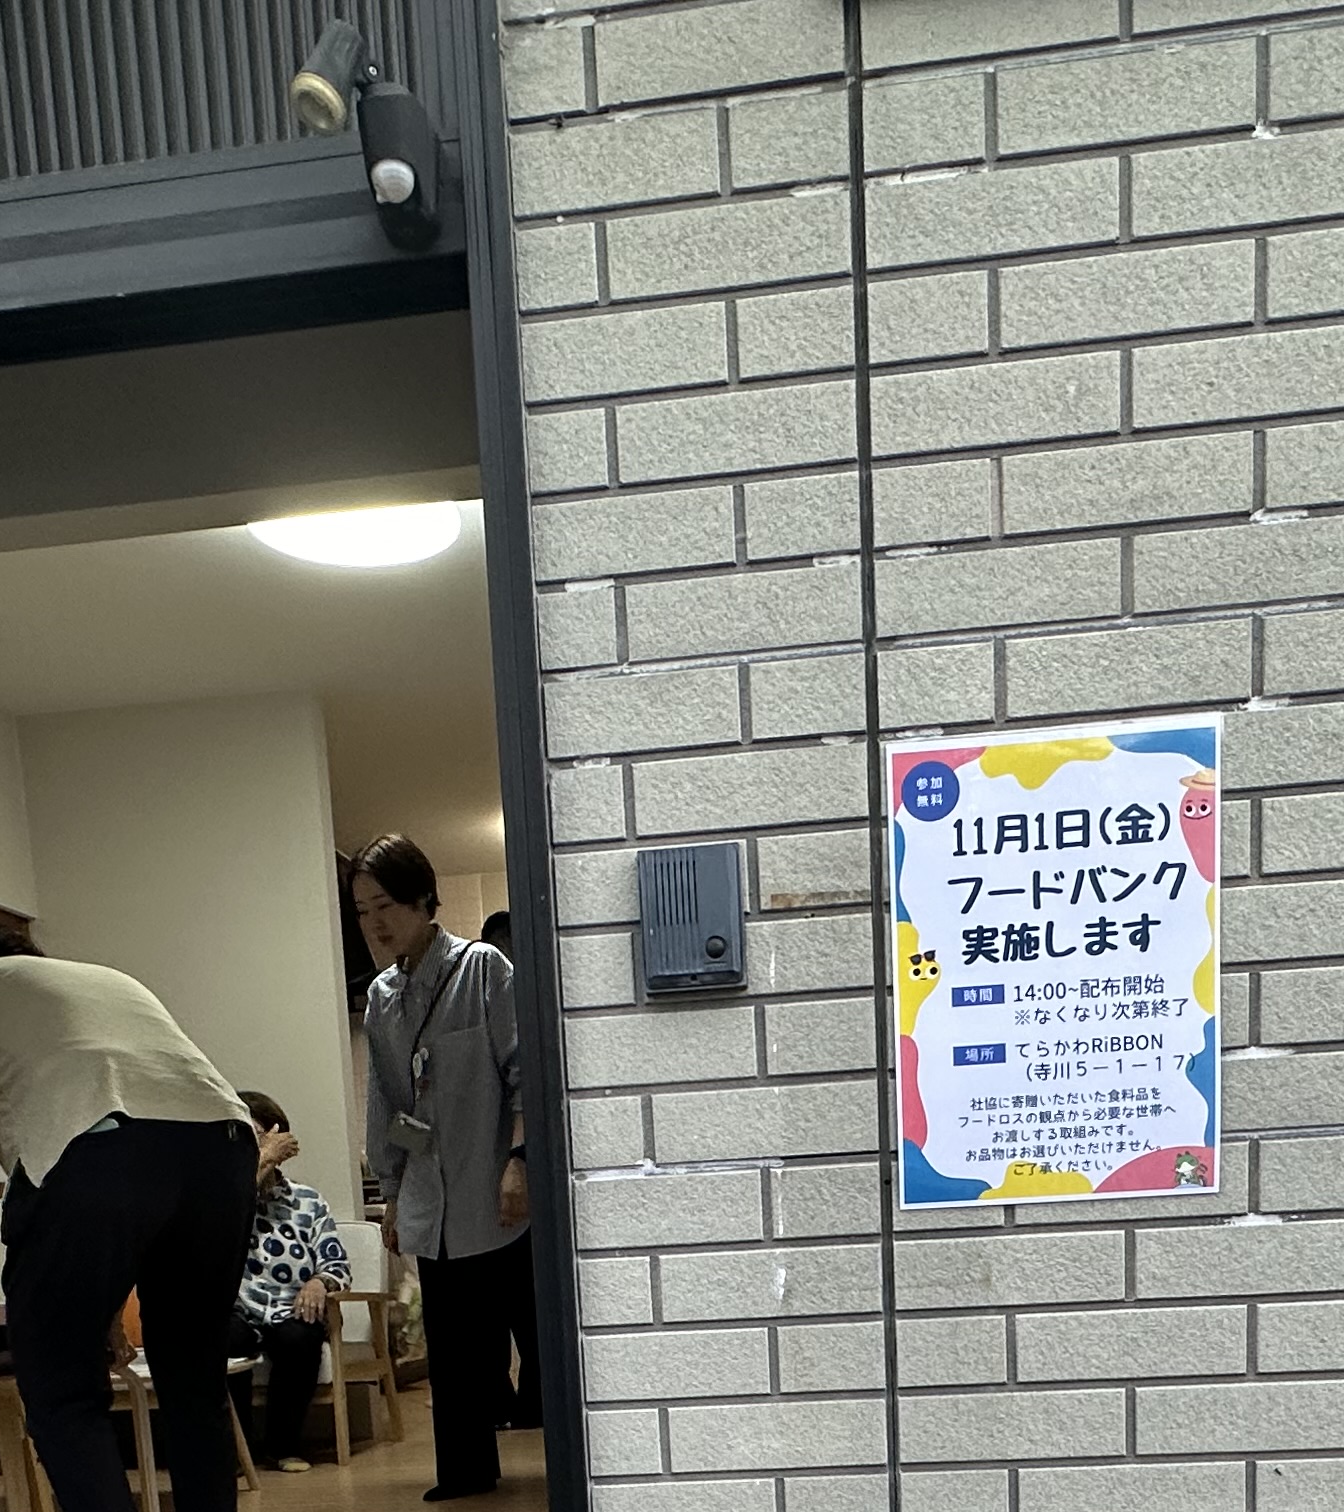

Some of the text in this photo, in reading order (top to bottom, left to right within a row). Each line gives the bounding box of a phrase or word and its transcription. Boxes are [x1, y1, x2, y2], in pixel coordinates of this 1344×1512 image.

[916, 776, 943, 791] 参加
[916, 793, 943, 808] 無料
[952, 801, 1172, 857] 11月1日(金)
[947, 861, 1188, 915] フードバンク
[961, 913, 1162, 966] 実施します
[963, 987, 993, 1003] 時間
[964, 1047, 996, 1063] 場所
[1014, 1034, 1164, 1059] てらかわRiBBON
[970, 1087, 1162, 1112] 社協に寄贈いただいた食料品を
[958, 1104, 1177, 1128] フードロスの観点から必要な世帯へ
[991, 1124, 1134, 1144] お渡しする取組みです。
[965, 1139, 1162, 1163] お品物はお選びいただけません。
[1013, 1159, 1113, 1177] ご了承ください。
